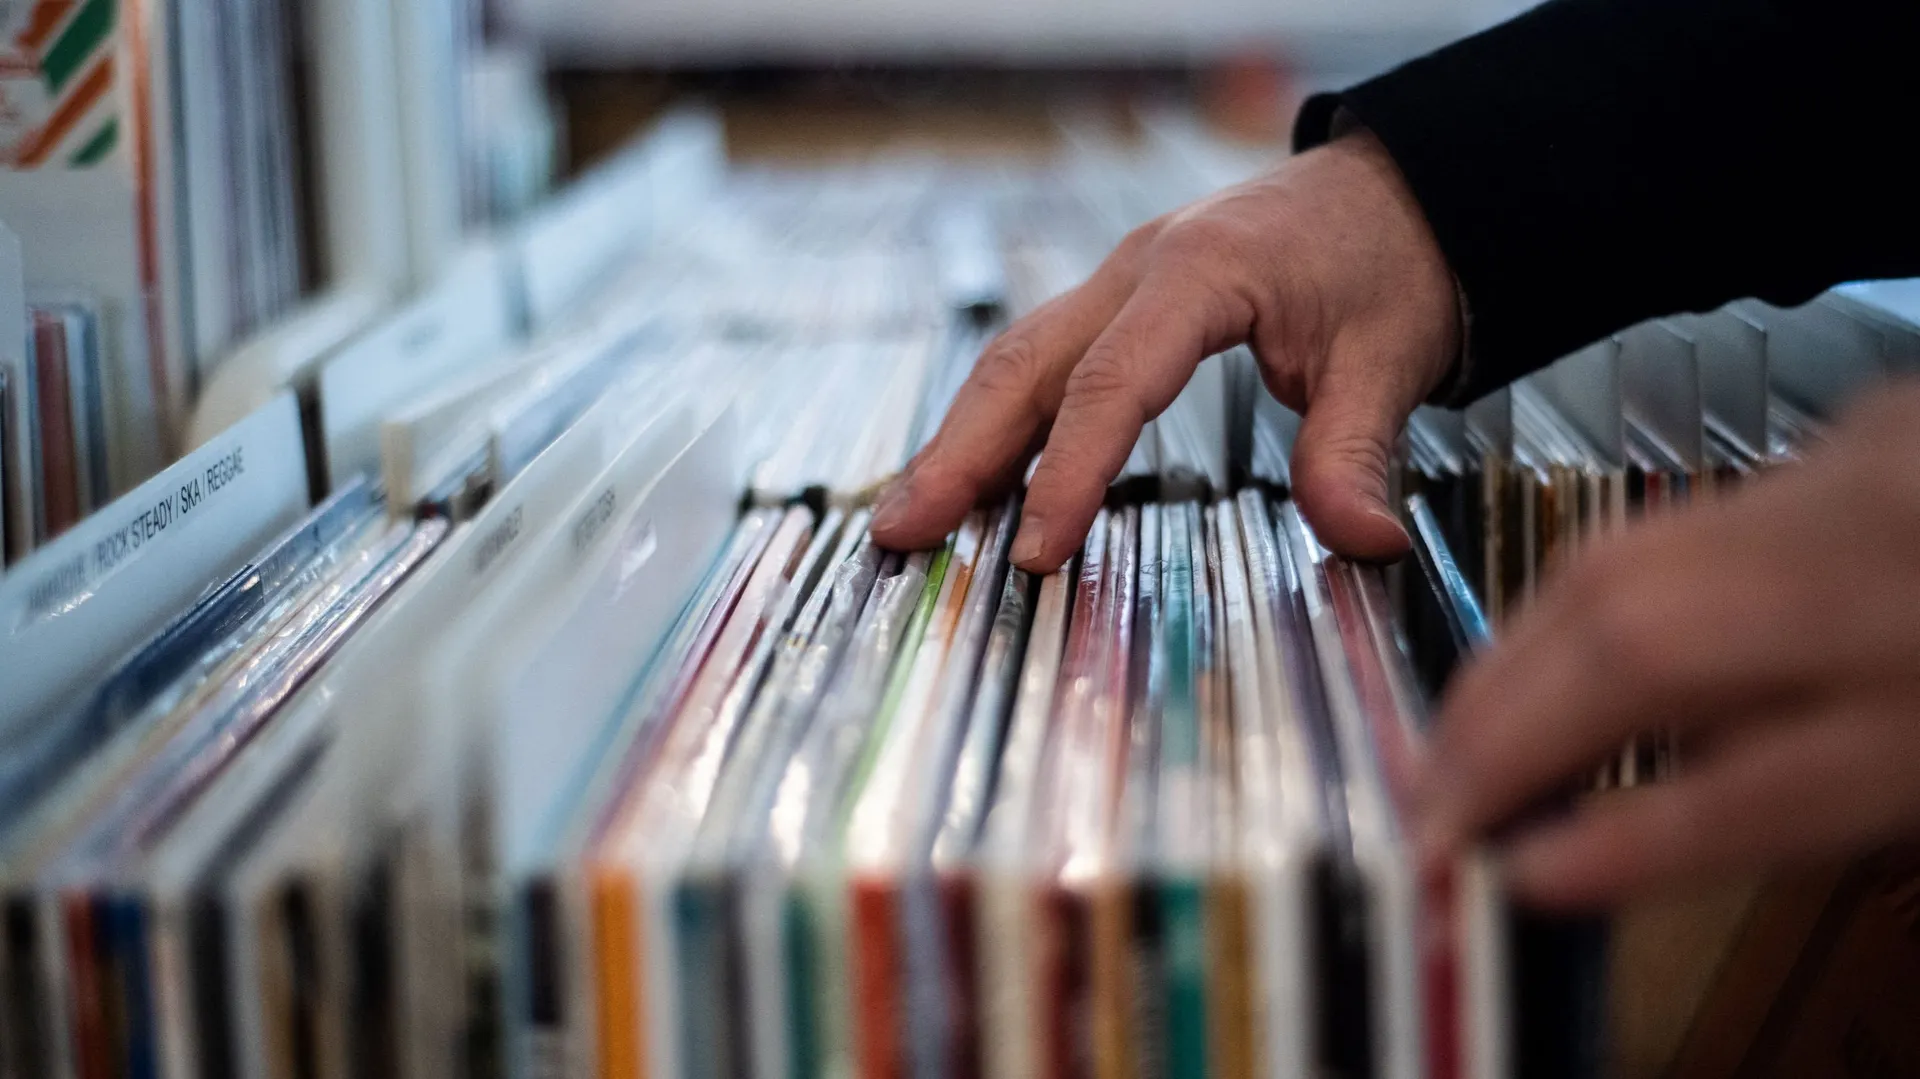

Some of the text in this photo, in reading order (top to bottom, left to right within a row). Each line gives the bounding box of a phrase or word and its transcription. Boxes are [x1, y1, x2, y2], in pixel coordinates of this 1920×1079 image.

[132, 495, 173, 549] STEADY
[181, 478, 202, 514] SKA
[206, 446, 245, 495] REGGAE
